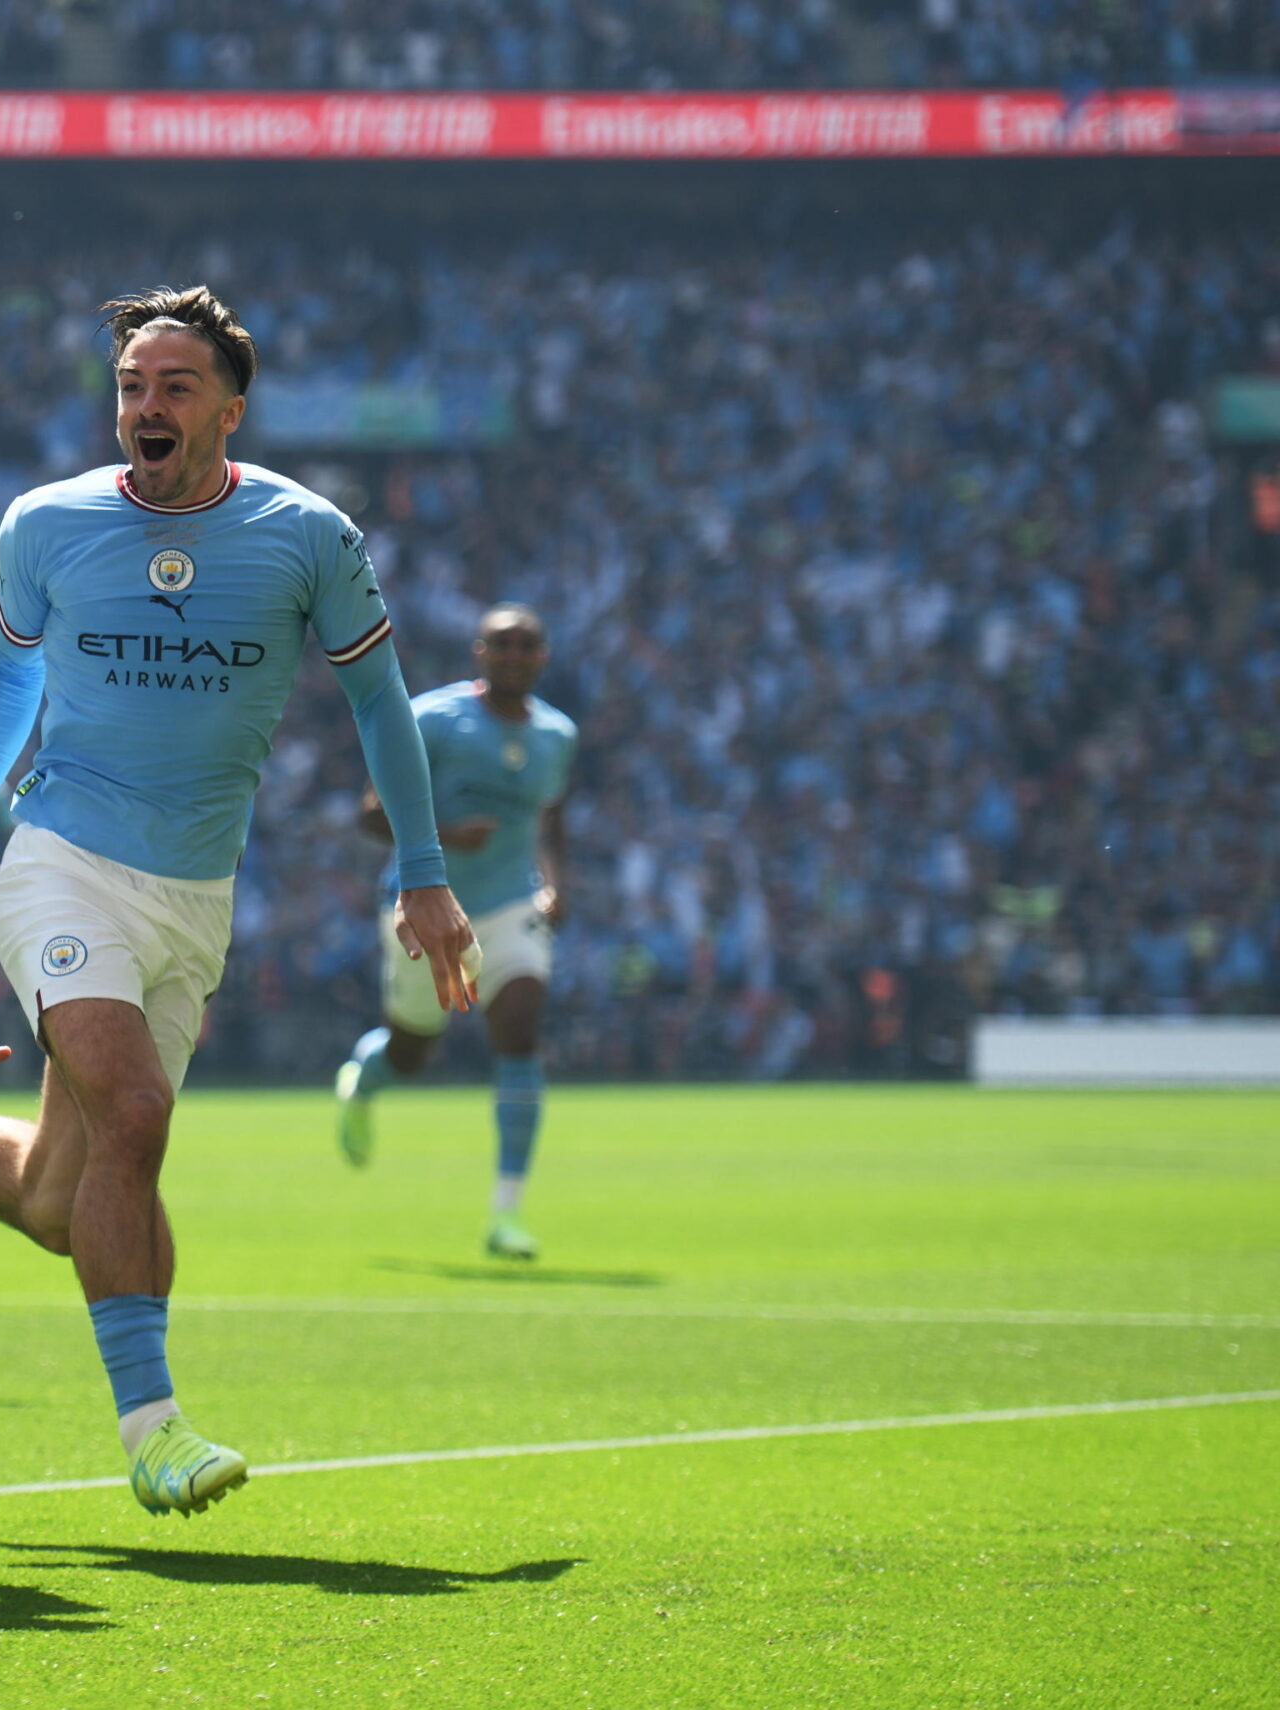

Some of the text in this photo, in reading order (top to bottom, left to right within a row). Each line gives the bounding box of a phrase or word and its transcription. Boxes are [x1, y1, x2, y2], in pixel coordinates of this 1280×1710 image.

[152, 551, 190, 566] MANCHESTER
[78, 633, 265, 667] ETIHAD
[105, 669, 230, 692] AIRWAYS
